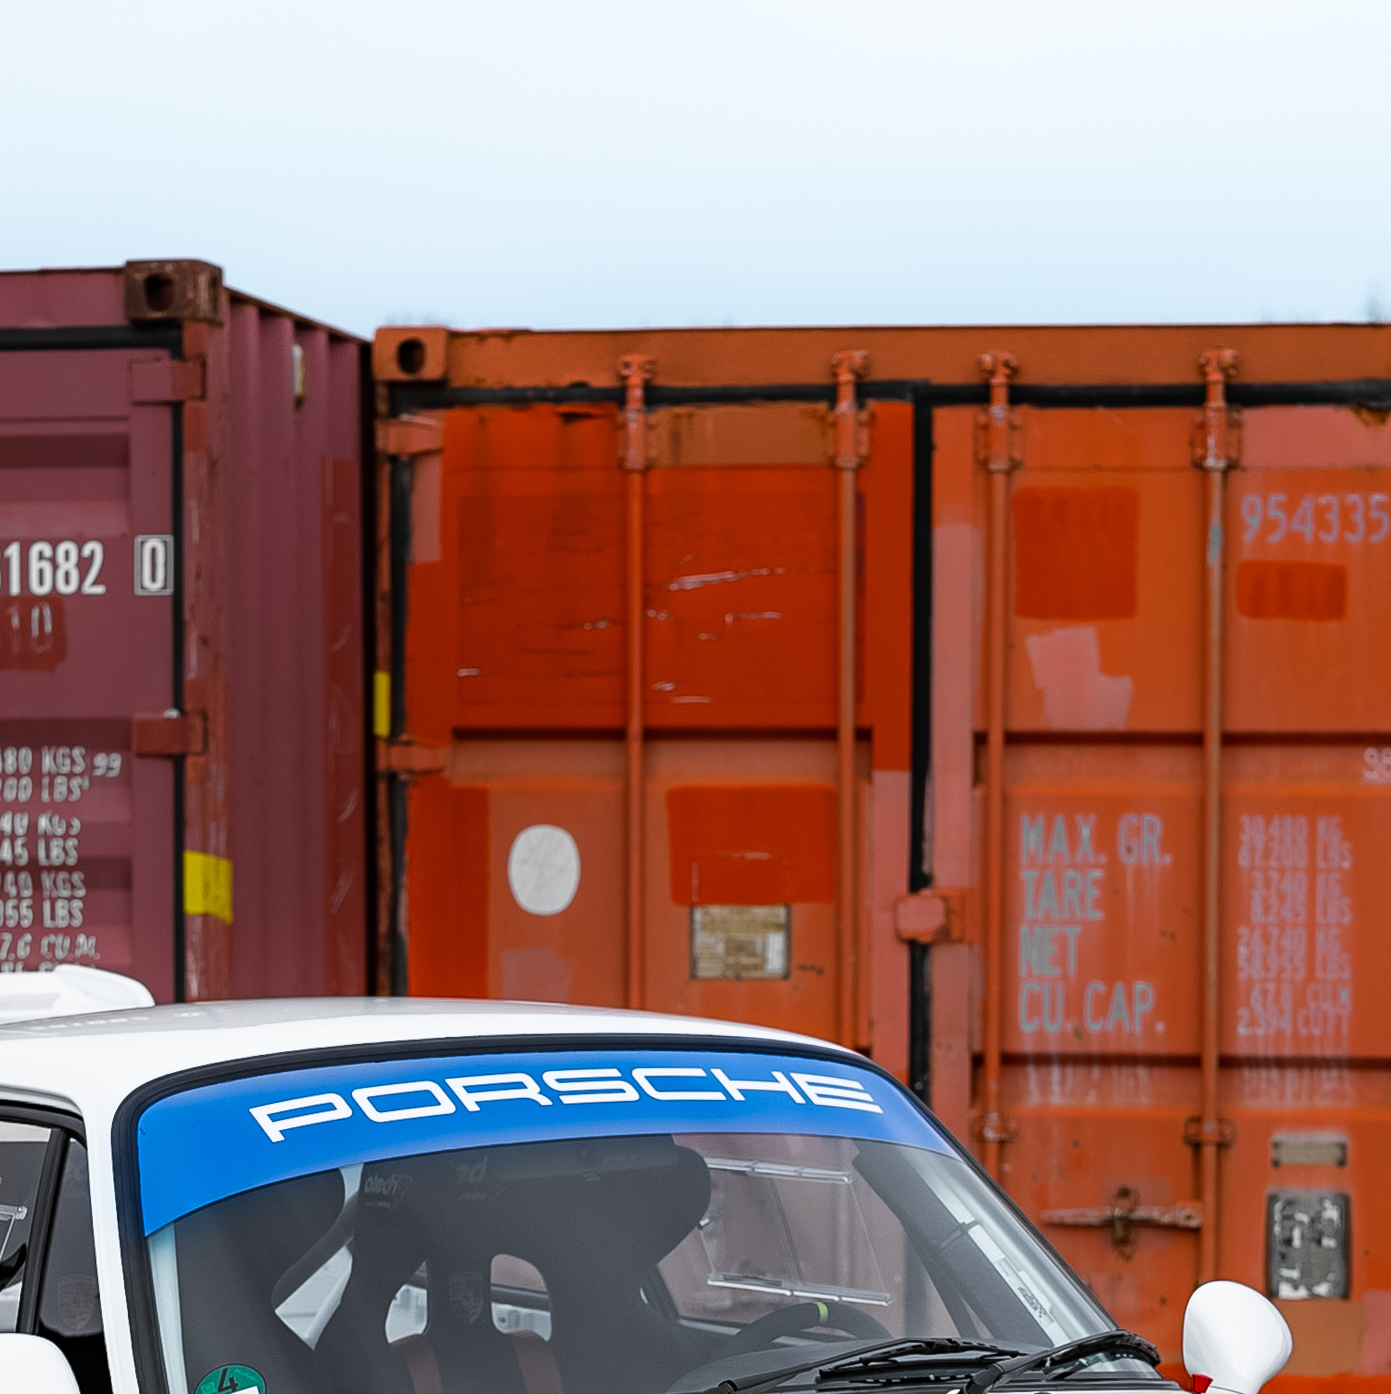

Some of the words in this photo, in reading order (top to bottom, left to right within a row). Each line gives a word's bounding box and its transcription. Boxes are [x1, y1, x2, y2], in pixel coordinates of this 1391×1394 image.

[1241, 493, 1391, 543] 954335
[142, 538, 167, 592] 0
[41, 746, 86, 775] KGS
[93, 752, 122, 778] 99
[37, 837, 78, 866] LBS
[40, 870, 86, 898] KGS
[1020, 869, 1105, 920] TARE
[42, 899, 84, 928] LBS
[1020, 925, 1079, 976] NET
[249, 1067, 884, 1143] PORSCHE
[217, 1367, 239, 1393] 4
